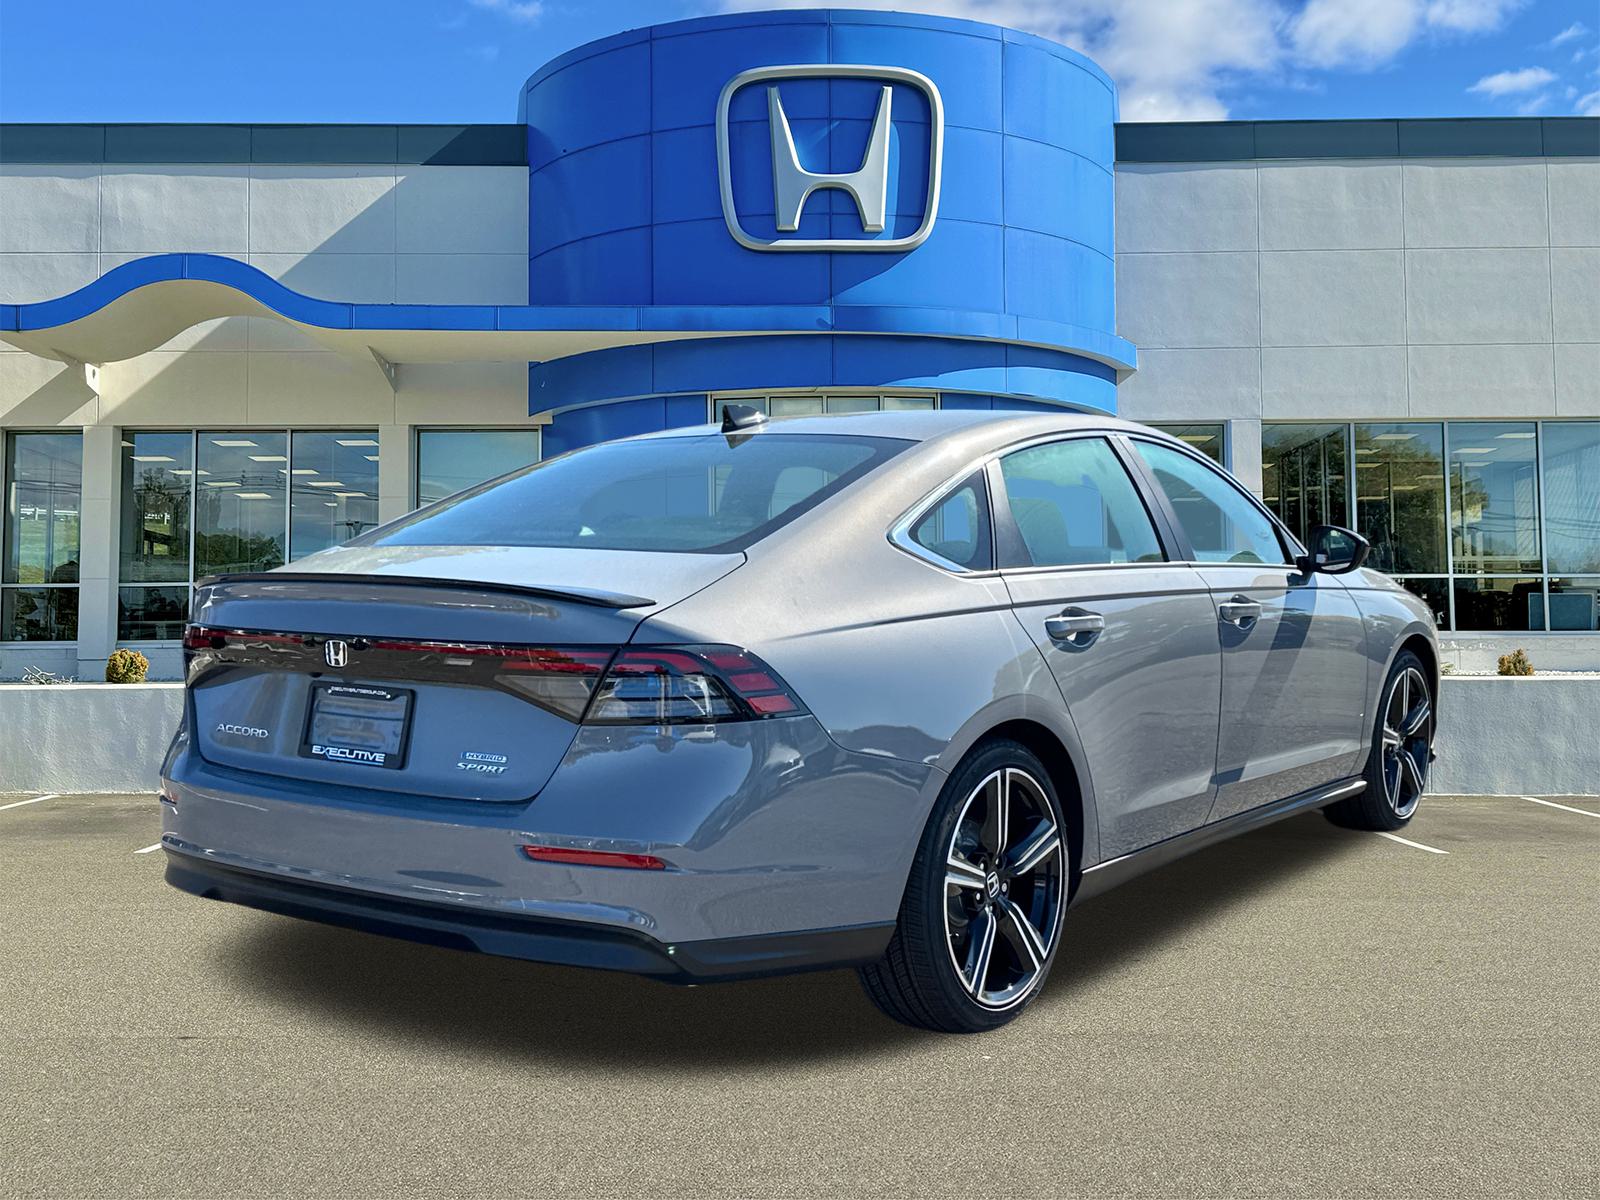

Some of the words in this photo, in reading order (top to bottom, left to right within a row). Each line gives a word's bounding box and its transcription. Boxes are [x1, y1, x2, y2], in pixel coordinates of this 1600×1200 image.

[216, 723, 269, 738] ACCORD
[312, 745, 386, 762] EXECUTIVE
[464, 752, 507, 763] HYBRID
[456, 762, 508, 774] SPORT
